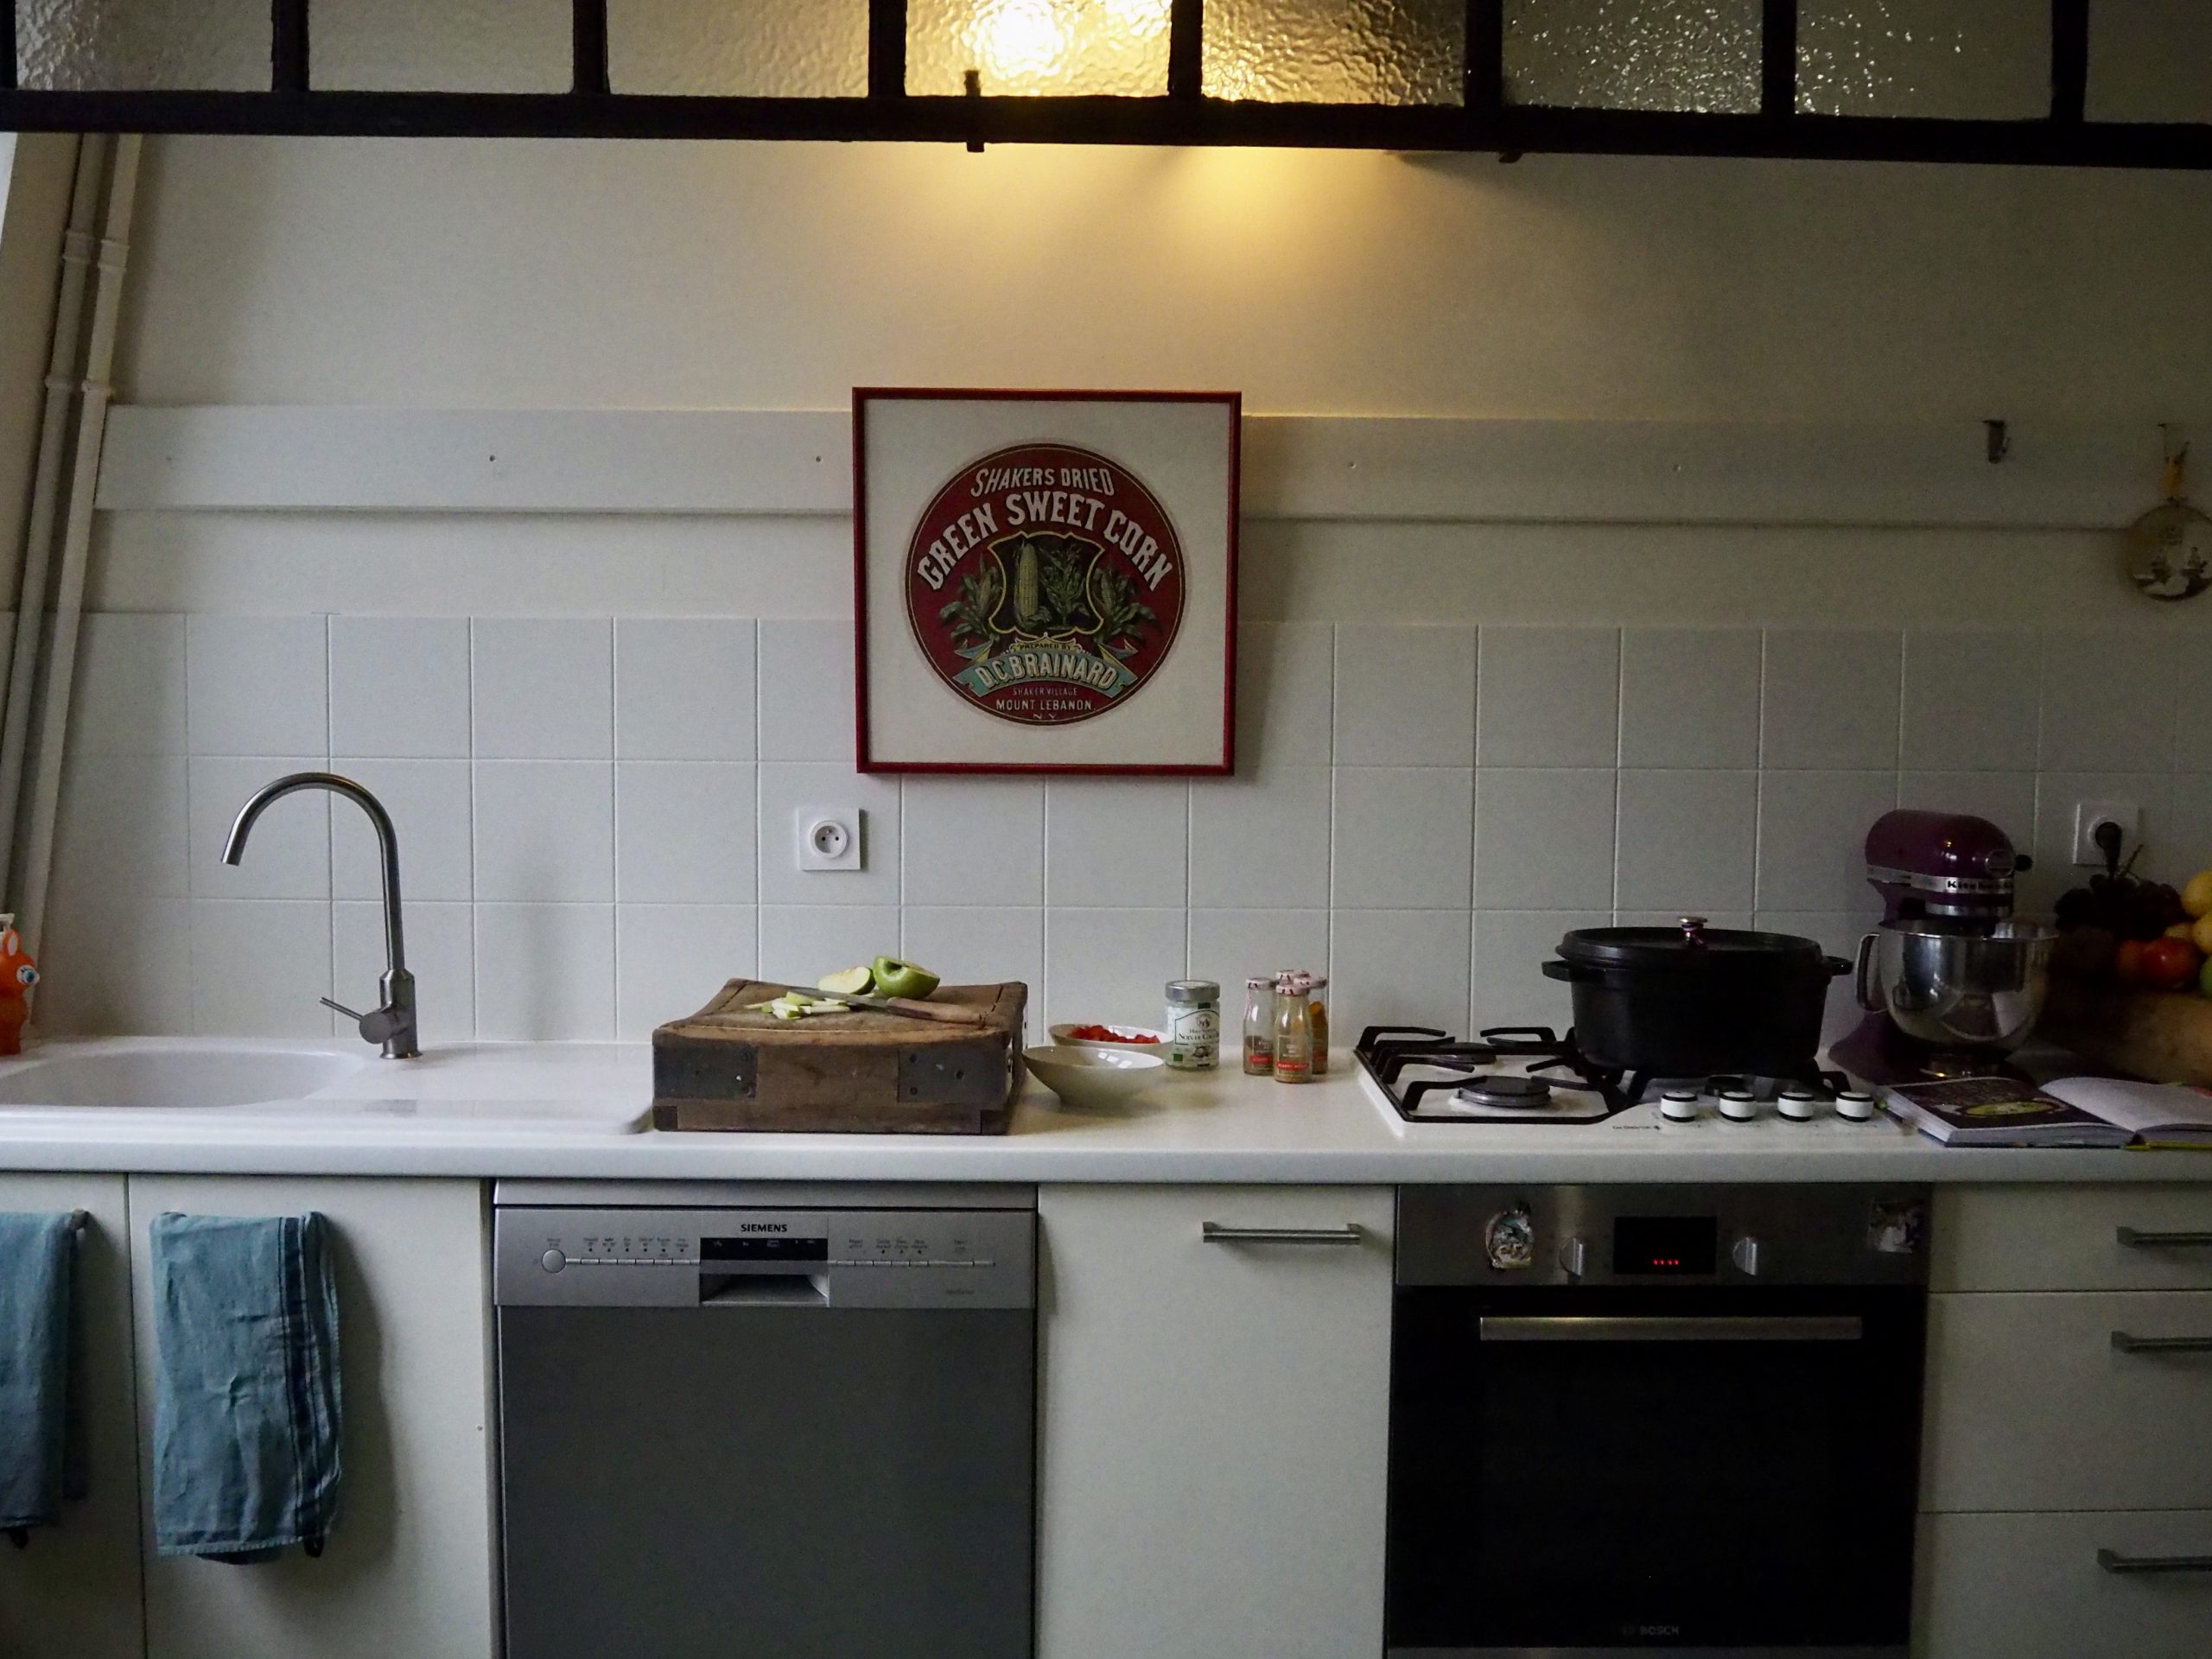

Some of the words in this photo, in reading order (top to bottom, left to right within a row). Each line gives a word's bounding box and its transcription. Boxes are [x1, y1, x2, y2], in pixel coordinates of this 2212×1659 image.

[970, 467, 1055, 498] SHAKERS
[1061, 467, 1115, 496] DRIED
[916, 502, 999, 590] GREEN
[1006, 490, 1105, 531] SWEET
[1102, 509, 1173, 591] CORN
[1013, 687, 1045, 696] SHAKER
[1046, 687, 1078, 696] VILLAGE
[995, 699, 1036, 711] MOUNT
[741, 1224, 788, 1233] SIEMENS
[1639, 1625, 1681, 1636] BOSCH
